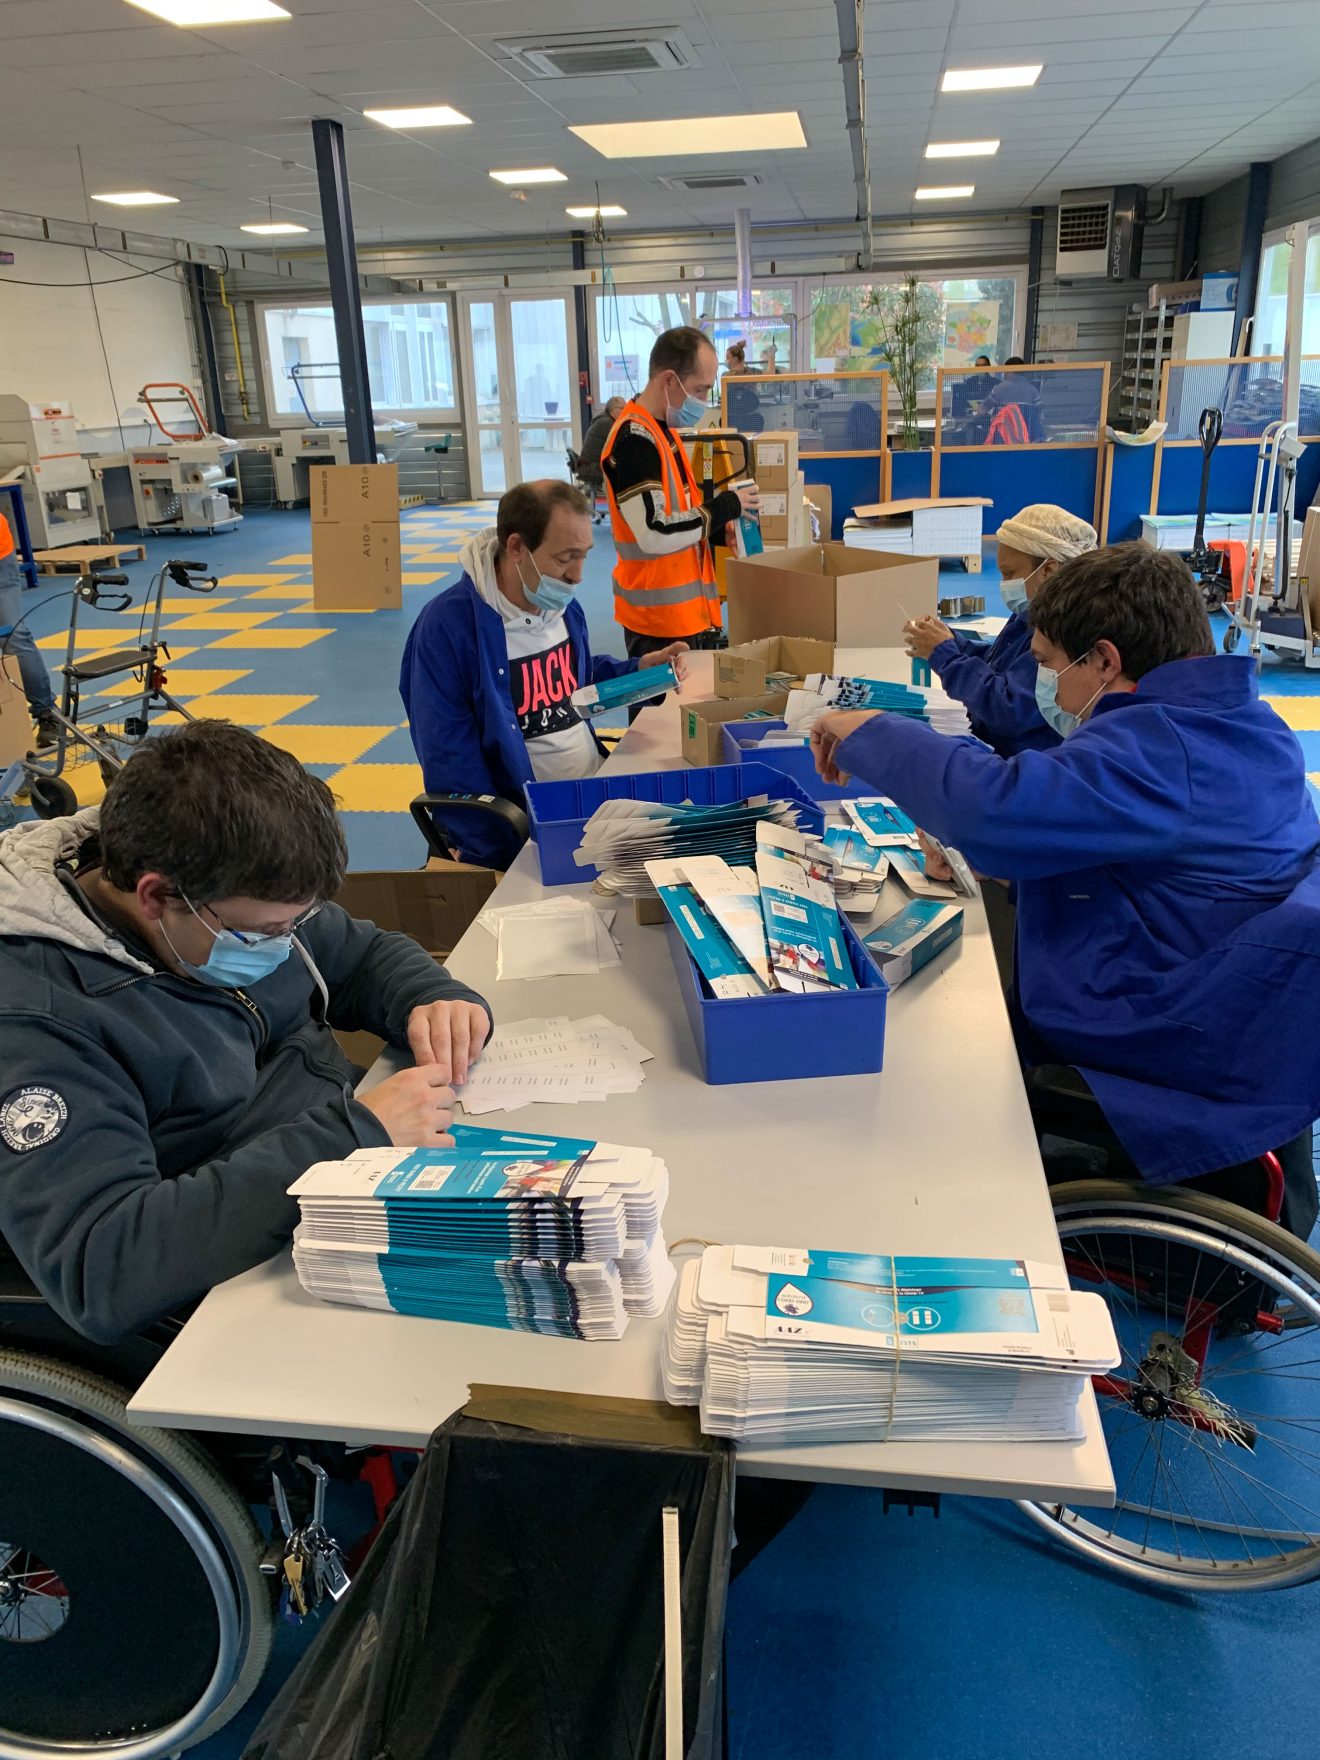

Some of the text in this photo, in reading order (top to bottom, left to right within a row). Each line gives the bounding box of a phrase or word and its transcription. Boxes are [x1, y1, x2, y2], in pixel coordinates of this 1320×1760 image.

[361, 476, 370, 500] A10
[362, 534, 372, 558] A10
[517, 643, 578, 716] JACK
